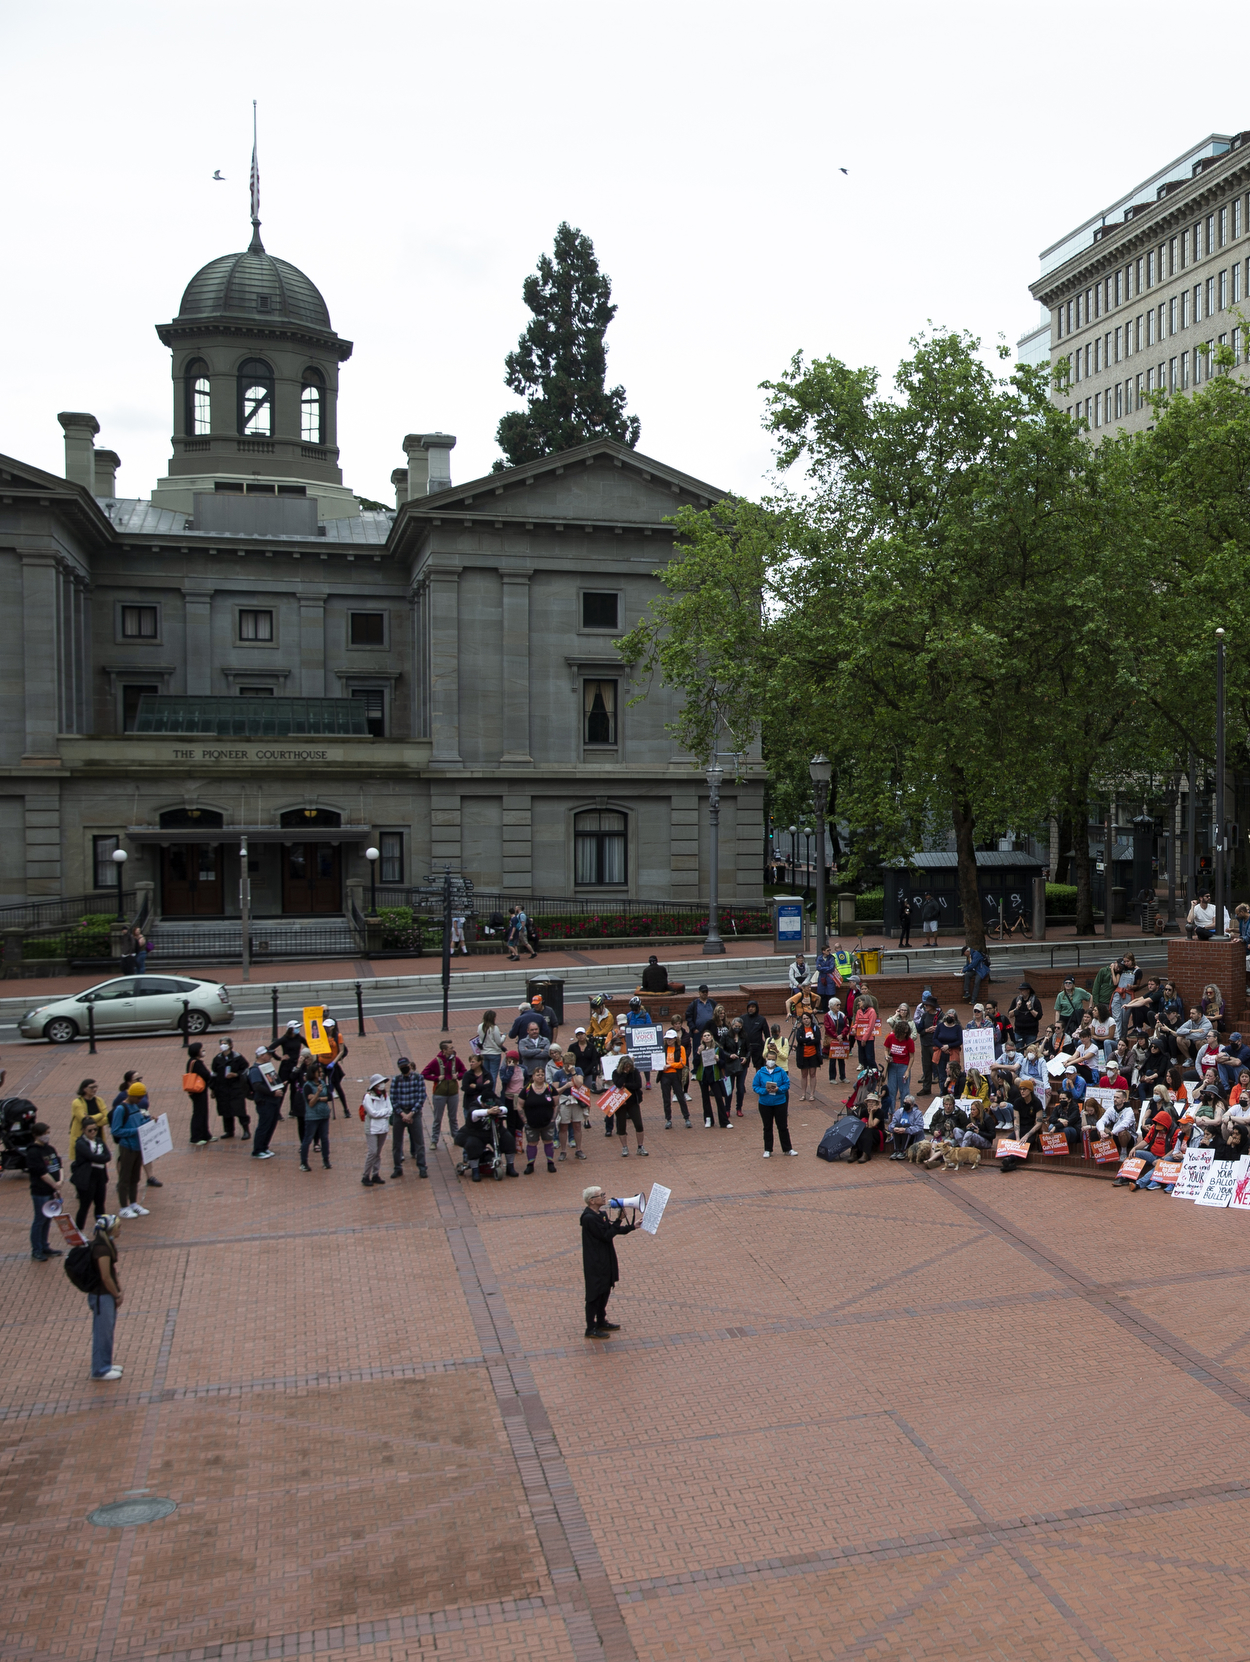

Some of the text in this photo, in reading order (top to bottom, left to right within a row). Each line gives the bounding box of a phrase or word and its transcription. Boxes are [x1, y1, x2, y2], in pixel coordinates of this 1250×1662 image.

[173, 749, 328, 759] THE PIONEER COURTHOUSE
[965, 1060, 994, 1069] ENABLING
[1042, 1133, 1062, 1142] Educators
[1051, 1141, 1068, 1149] Violence
[1093, 1140, 1113, 1149] Educators
[1006, 1146, 1028, 1154] Violence
[1221, 1161, 1234, 1170] LET
[1188, 1170, 1204, 1183] YOUR
[1217, 1169, 1233, 1178] YOUR
[1210, 1178, 1237, 1187] BALLOT
[1219, 1186, 1233, 1194] YOUR
[1203, 1192, 1228, 1201] BULLET
